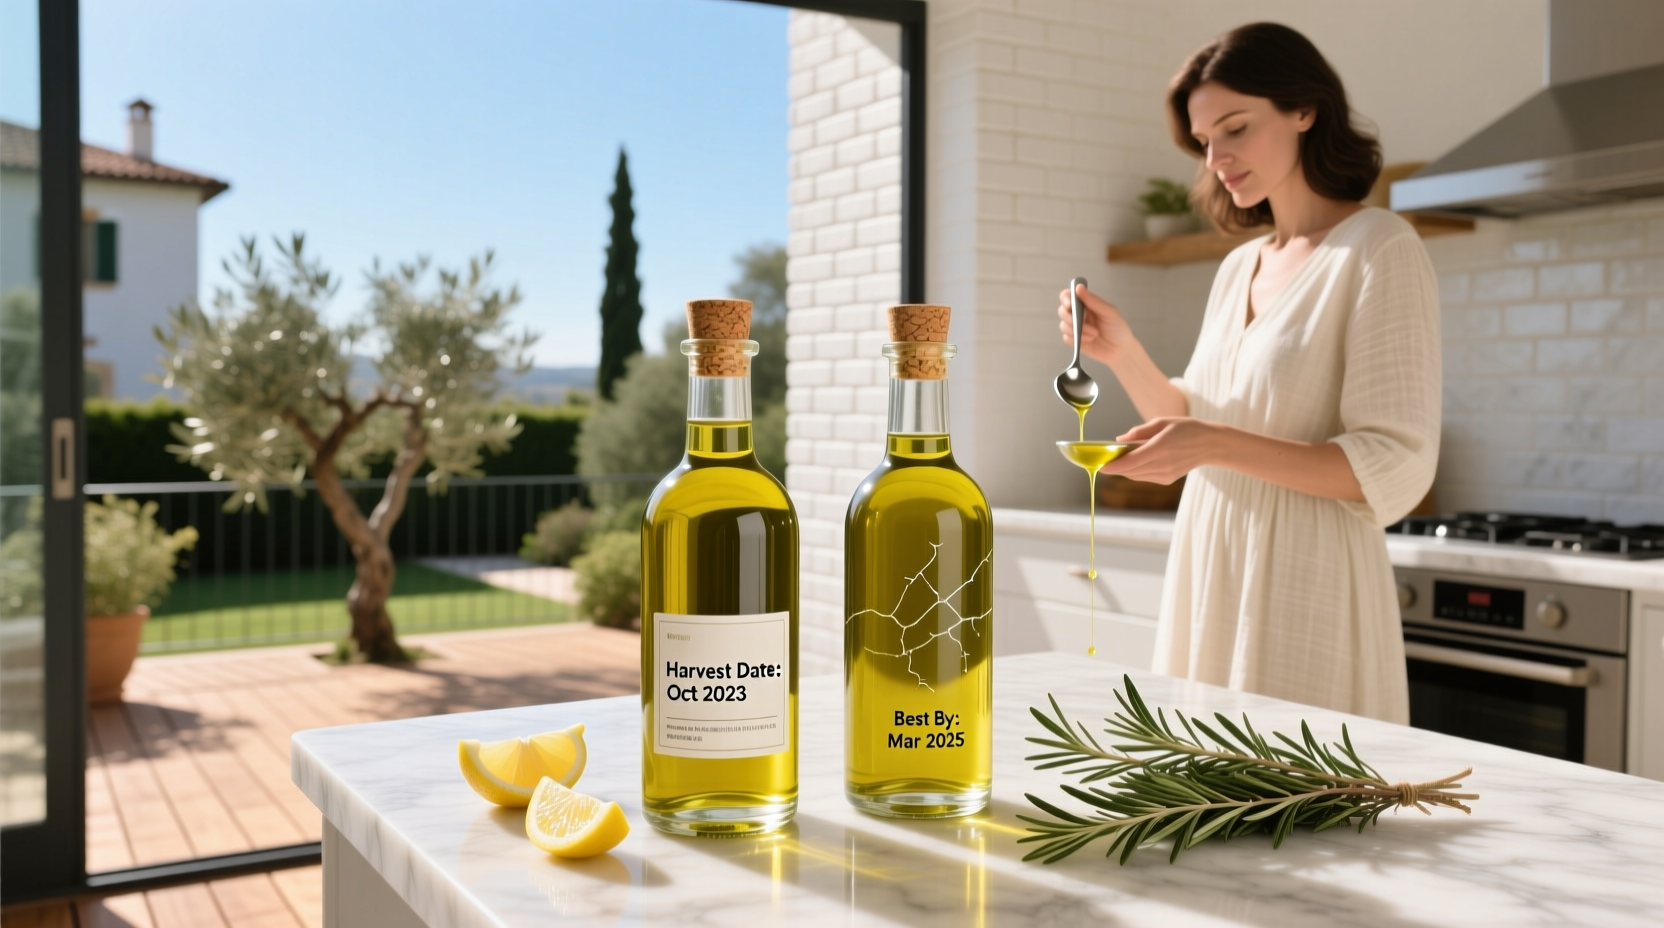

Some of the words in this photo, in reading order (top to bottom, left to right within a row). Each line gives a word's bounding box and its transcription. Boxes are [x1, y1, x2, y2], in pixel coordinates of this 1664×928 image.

[666, 661, 732, 679] Harvest
[737, 662, 781, 679] Date:
[667, 684, 698, 702] Oct
[703, 685, 747, 702] 2023
[894, 710, 930, 726] Best
[934, 710, 960, 730] By:
[888, 733, 921, 748] Mar
[926, 732, 965, 748] 2025
